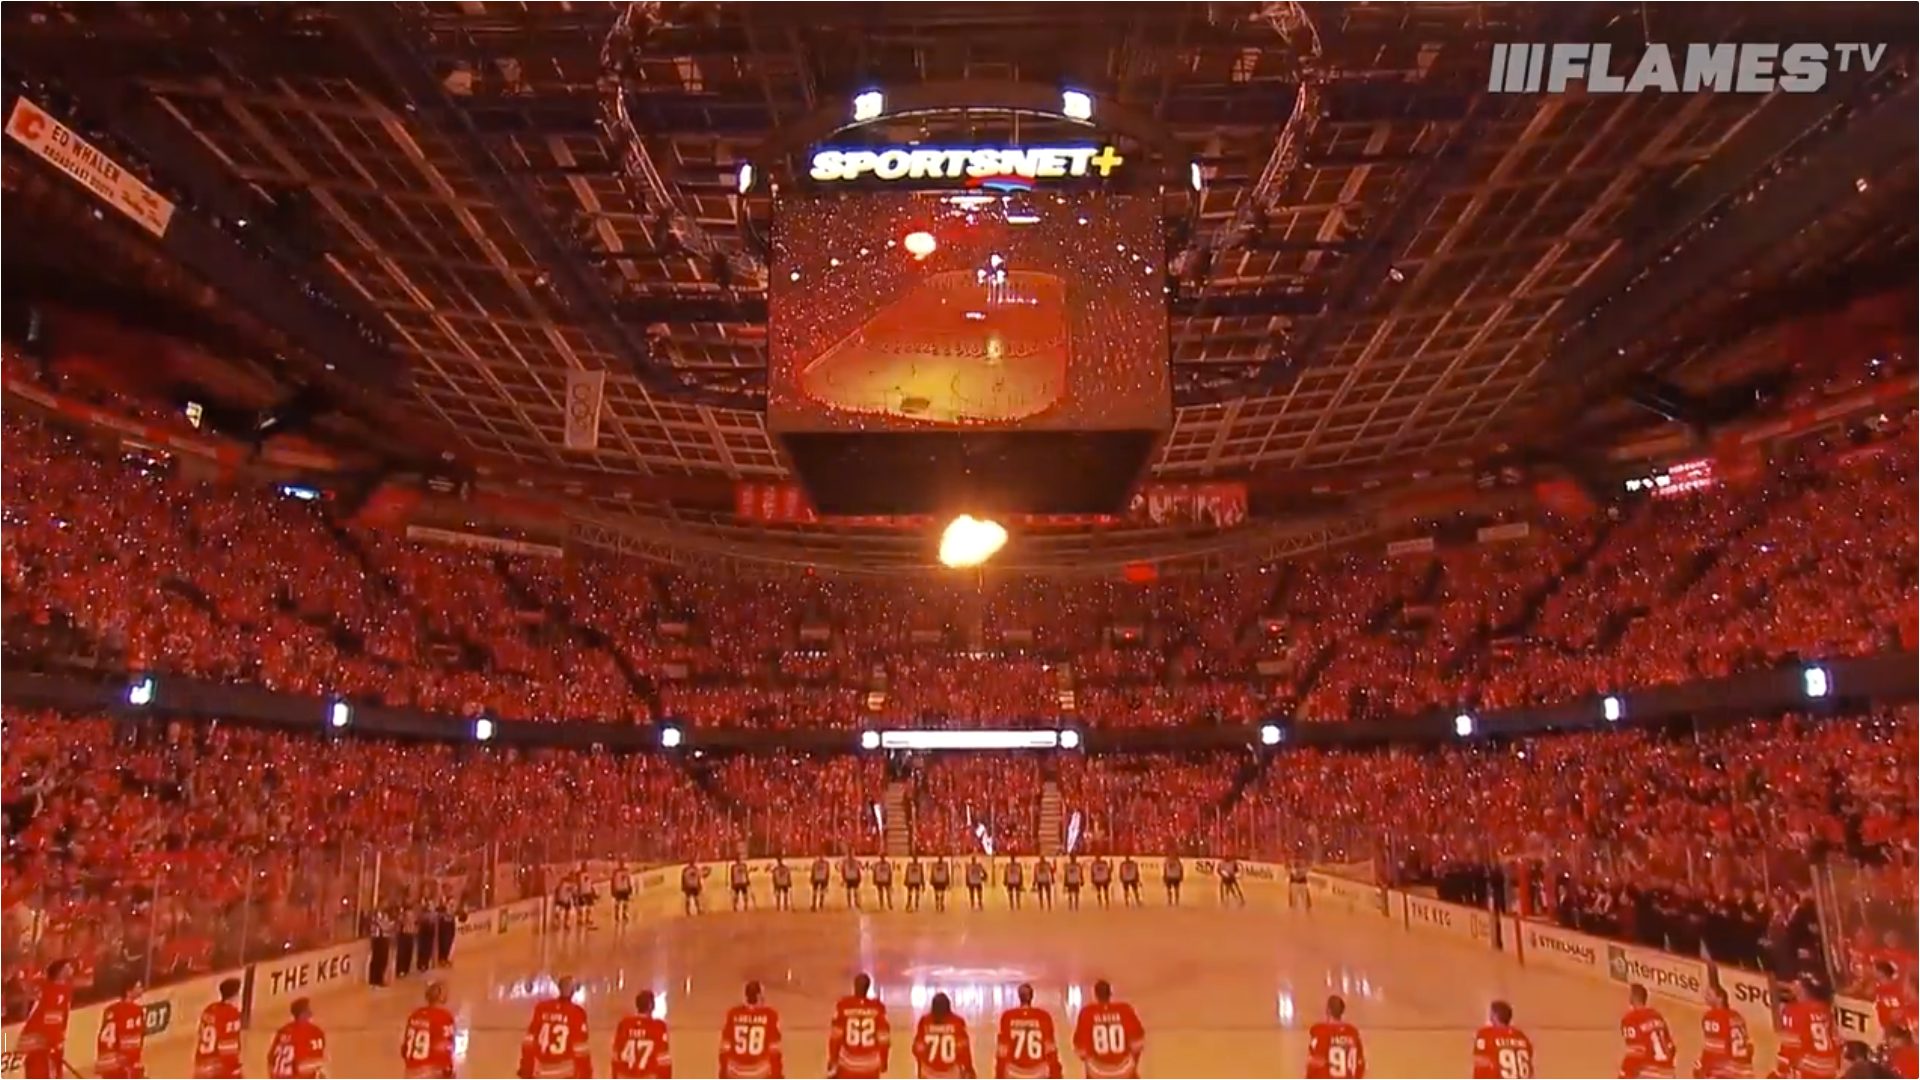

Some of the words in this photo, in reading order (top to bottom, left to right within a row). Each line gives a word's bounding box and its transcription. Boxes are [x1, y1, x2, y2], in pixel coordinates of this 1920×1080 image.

[51, 125, 70, 147] ED
[72, 140, 121, 184] WHALEN
[270, 963, 310, 996] THE
[316, 953, 351, 984] KEG
[1612, 956, 1700, 993] enterprise
[538, 1022, 569, 1055] 43
[734, 1024, 765, 1056] 58
[846, 1017, 876, 1047] 62
[1010, 1029, 1042, 1060] 76
[1092, 1024, 1125, 1054] 80
[620, 1039, 654, 1070] 47
[923, 1034, 956, 1064] 70
[1328, 1046, 1357, 1077] 94
[1498, 1048, 1530, 1079] 96
